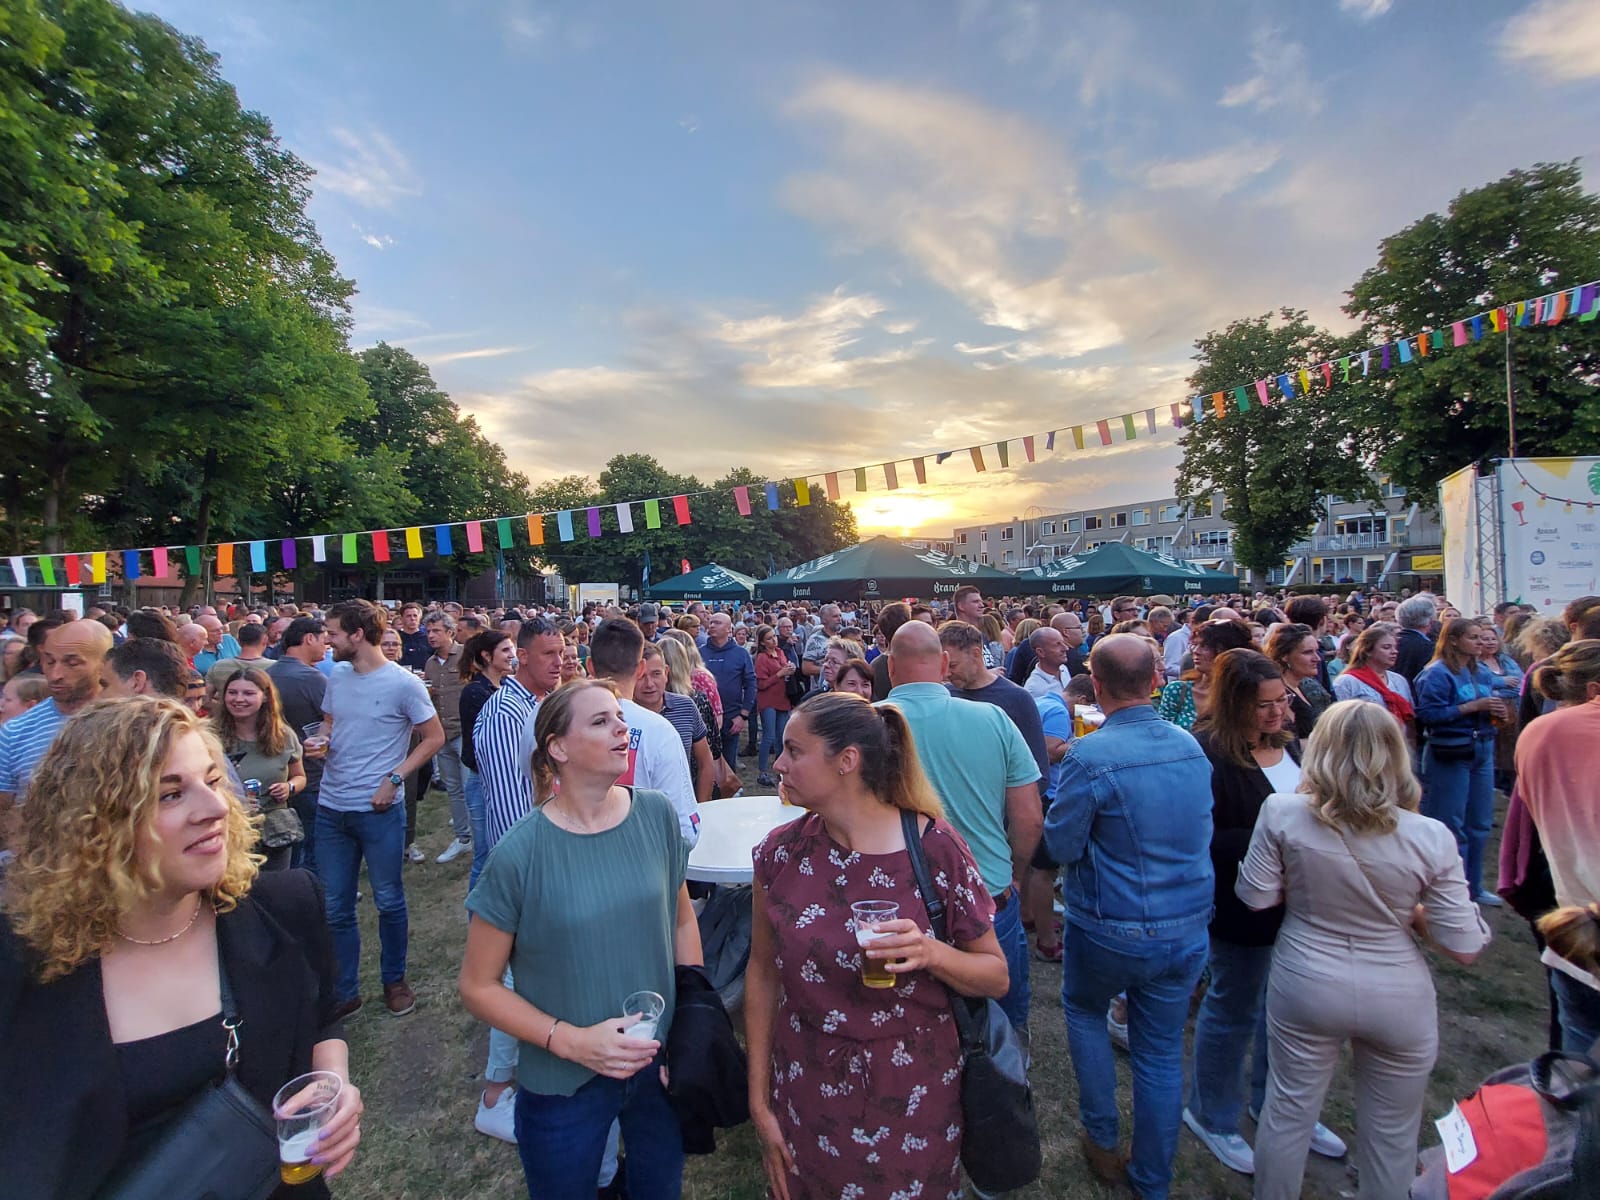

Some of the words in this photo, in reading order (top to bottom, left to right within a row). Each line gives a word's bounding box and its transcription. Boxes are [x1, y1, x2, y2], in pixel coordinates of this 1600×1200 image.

[792, 586, 811, 598] Brand
[933, 581, 960, 594] Brand
[1051, 582, 1076, 593] Brand
